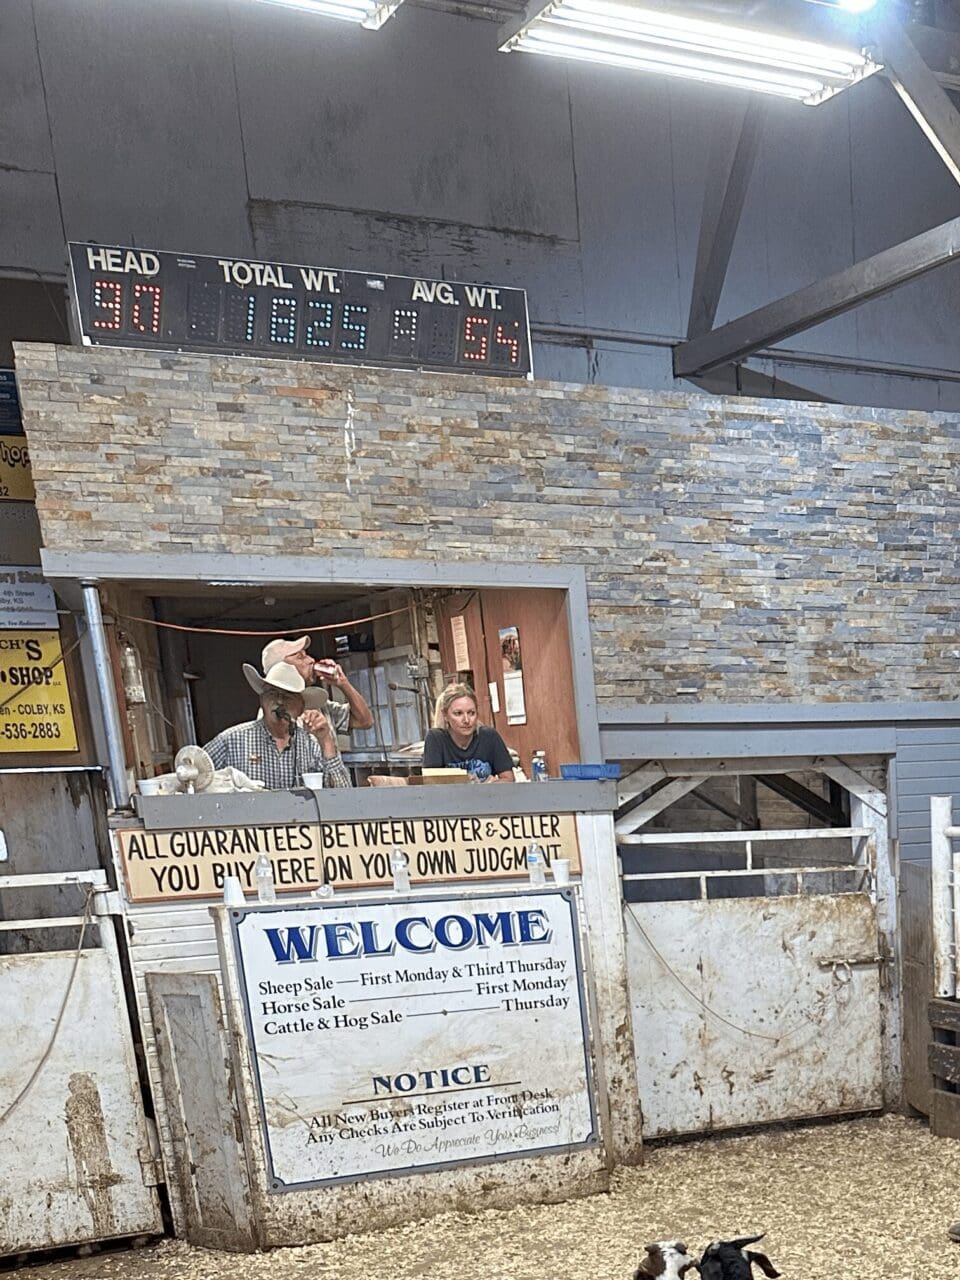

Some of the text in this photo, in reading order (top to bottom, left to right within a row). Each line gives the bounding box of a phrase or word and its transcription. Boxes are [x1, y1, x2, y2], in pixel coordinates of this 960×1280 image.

[86, 247, 160, 275] HEAD
[218, 260, 293, 289] TOTAL
[300, 268, 340, 293] WT.
[412, 280, 460, 305] AVG.
[464, 286, 502, 310] WT.
[246, 296, 368, 350] 1825
[9, 666, 53, 686] SHOP
[17, 704, 52, 716] COLBY,
[53, 704, 65, 714] KS
[128, 814, 561, 860] ALL GUARANTEES BETWEEN BUYER & SELLER
[150, 863, 199, 892] YOU
[212, 860, 255, 889] BUY
[324, 854, 353, 881] ON
[416, 850, 456, 876] OWN
[464, 844, 562, 874] JUDGMNT
[262, 909, 553, 966] WELCOME
[258, 957, 567, 996] Sheep Sale First Monday & Third Thursday
[261, 976, 569, 1015] Horse Sale First Monday
[264, 995, 570, 1035] Cattle & Hog Sale Thursday
[372, 1064, 491, 1095] NOTICE
[310, 1115, 331, 1129] All
[334, 1113, 367, 1126] New
[370, 1107, 415, 1121] Buyers
[418, 1100, 470, 1116] Register
[472, 1098, 484, 1109] at
[521, 1087, 553, 1101] Desk
[307, 1132, 336, 1145] Any
[339, 1124, 389, 1140] Checks
[391, 1122, 416, 1133] Are
[418, 1115, 466, 1130] Subject
[468, 1111, 484, 1123] To
[423, 1134, 481, 1153] Appreciate
